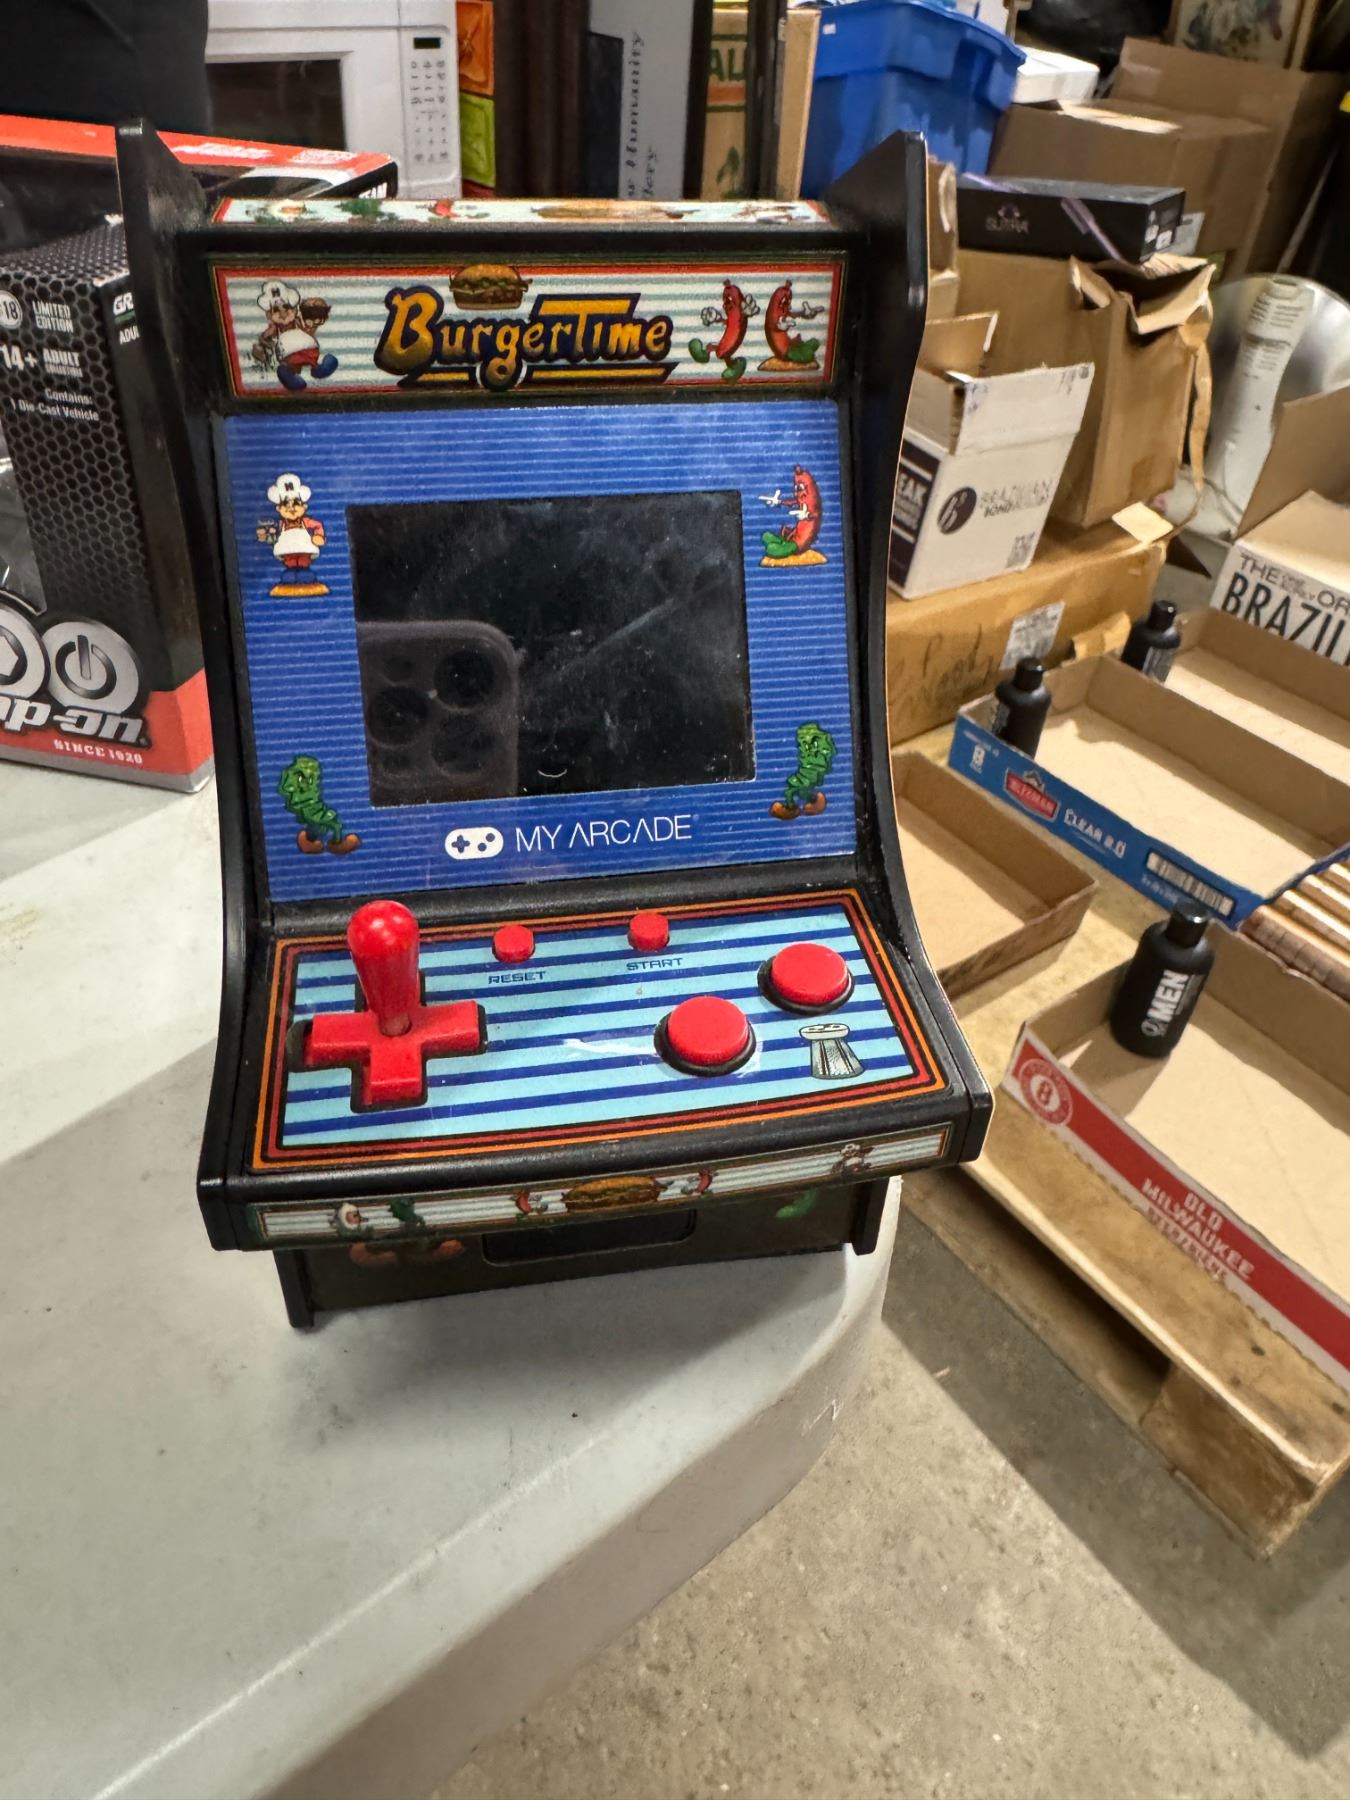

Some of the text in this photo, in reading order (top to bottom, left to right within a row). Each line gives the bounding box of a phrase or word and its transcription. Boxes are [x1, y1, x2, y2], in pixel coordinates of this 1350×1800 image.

[32, 301, 71, 318] LIMITED
[35, 314, 74, 333] EDITION
[375, 286, 675, 390] BurgerTime
[43, 348, 80, 367] ADULT
[18, 399, 60, 416] Die-Cast
[62, 406, 99, 421] Vehicle
[1240, 553, 1281, 585] THE
[1222, 572, 1350, 668] BRAZIL
[53, 739, 105, 758] SINCE
[516, 814, 692, 852] MY ARCADE
[626, 957, 683, 971] START
[488, 971, 546, 985] RESET
[1147, 969, 1189, 1023] MEN
[1184, 1192, 1223, 1232] OLD
[1142, 1178, 1255, 1281] MILWAUKEE
